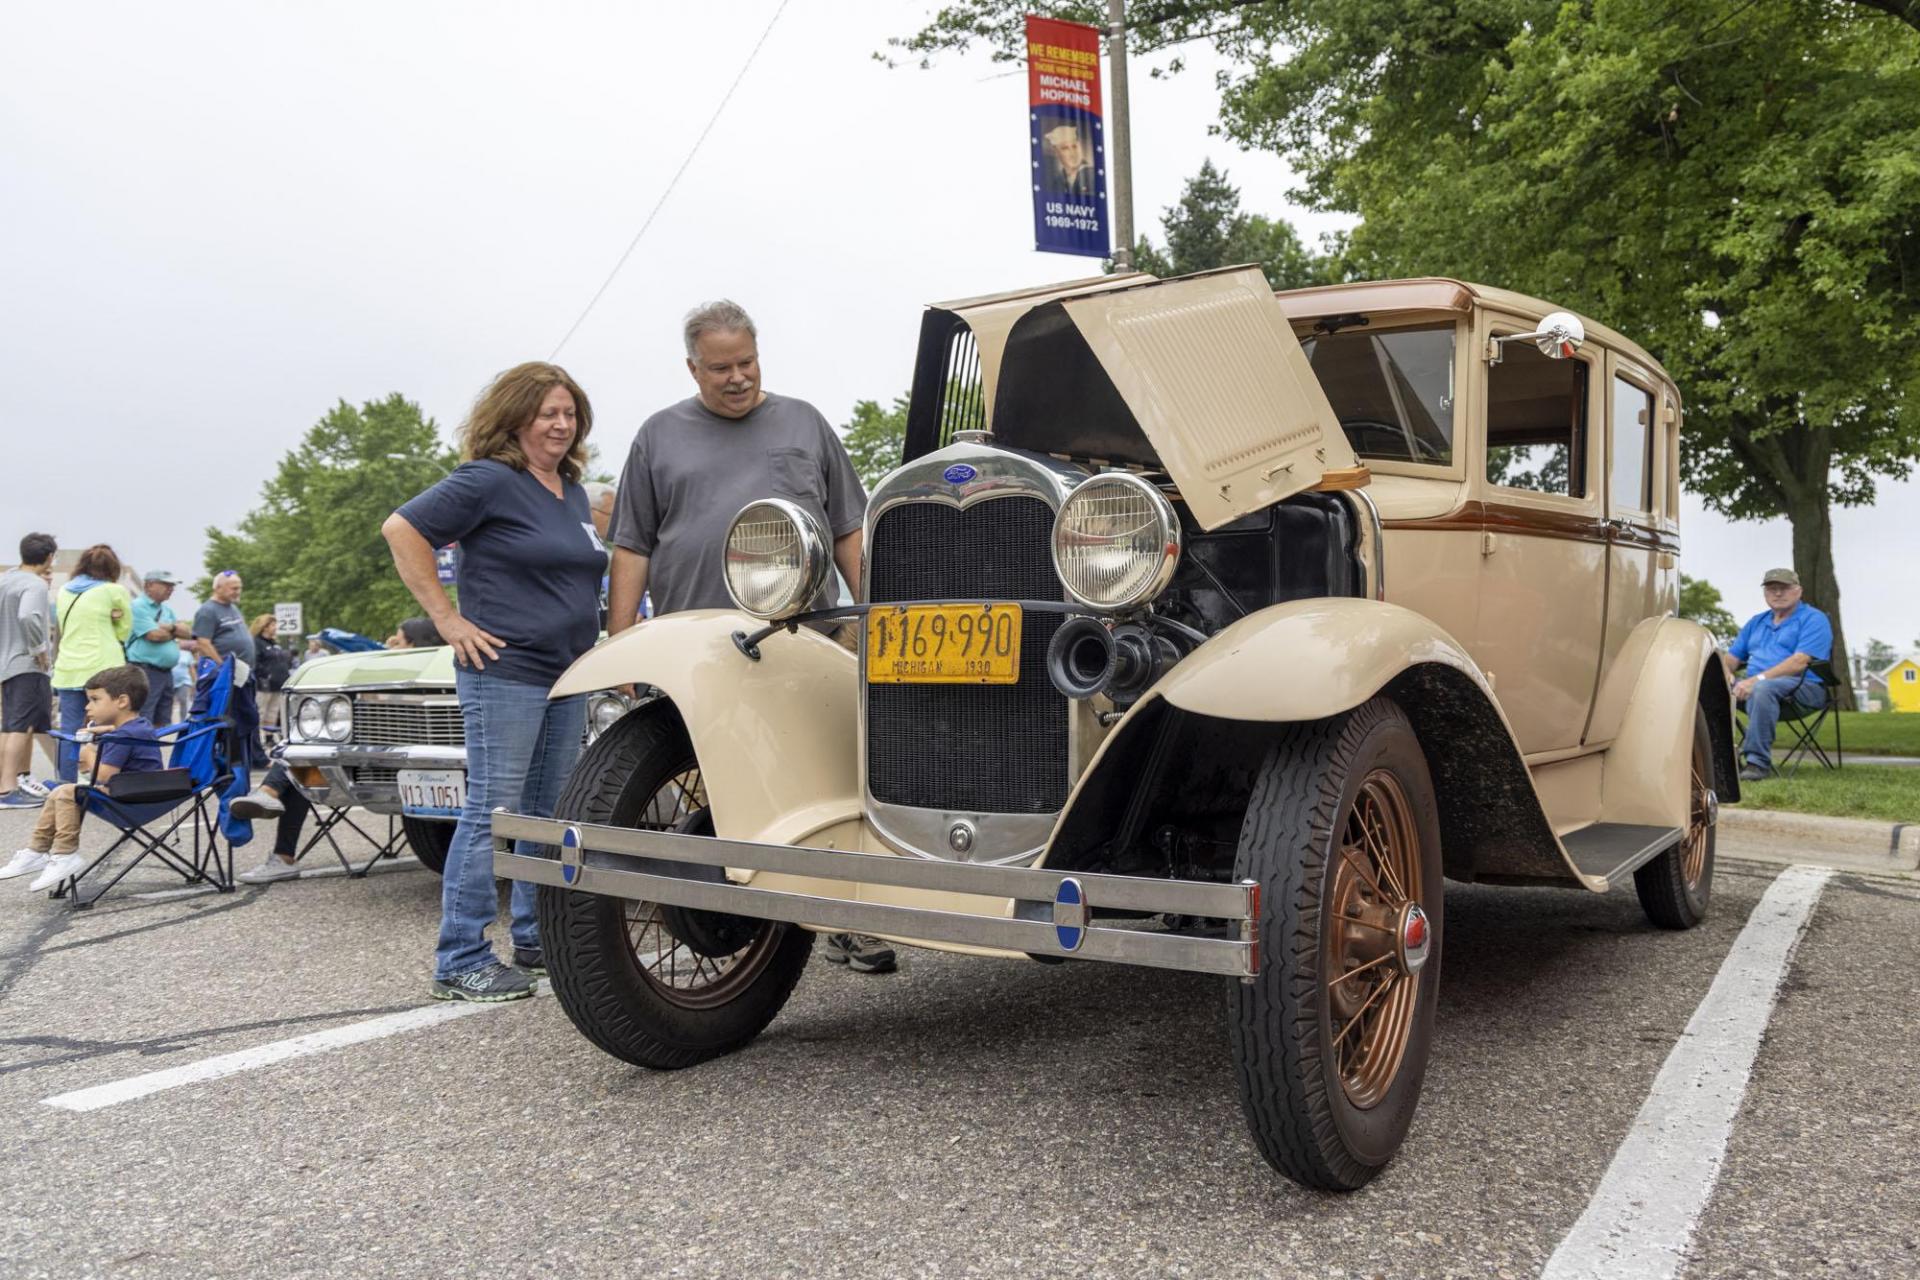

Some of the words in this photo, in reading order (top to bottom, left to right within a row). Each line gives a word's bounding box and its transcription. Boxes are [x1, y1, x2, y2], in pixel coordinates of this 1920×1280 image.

[1029, 43, 1045, 57] WE
[1046, 45, 1097, 66] REMEMBER
[1040, 74, 1090, 93] MICHAEL
[1040, 88, 1090, 106] HOPKINS
[1046, 202, 1063, 214] US
[1065, 203, 1095, 218] NAVY
[1045, 215, 1098, 231] 1969-1972
[279, 619, 298, 631] 25
[892, 660, 943, 675] MICHIGAN
[965, 660, 991, 675] 1930
[431, 785, 462, 809] 1051
